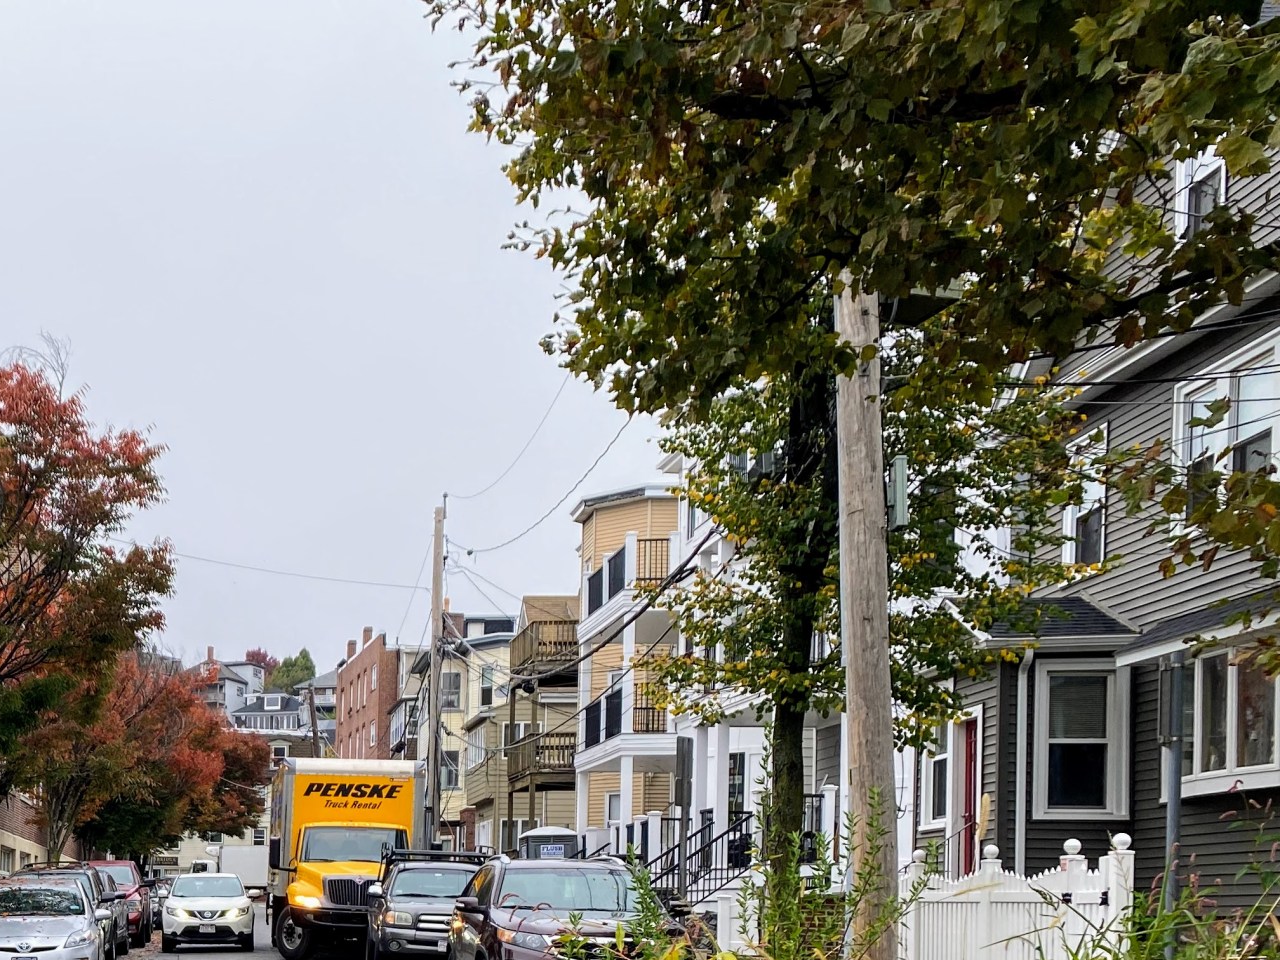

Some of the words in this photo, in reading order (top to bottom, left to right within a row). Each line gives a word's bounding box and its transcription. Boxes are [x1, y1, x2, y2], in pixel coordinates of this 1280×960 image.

[303, 782, 403, 799] PENSKE
[324, 799, 349, 809] Truck
[350, 800, 382, 810] Rental
